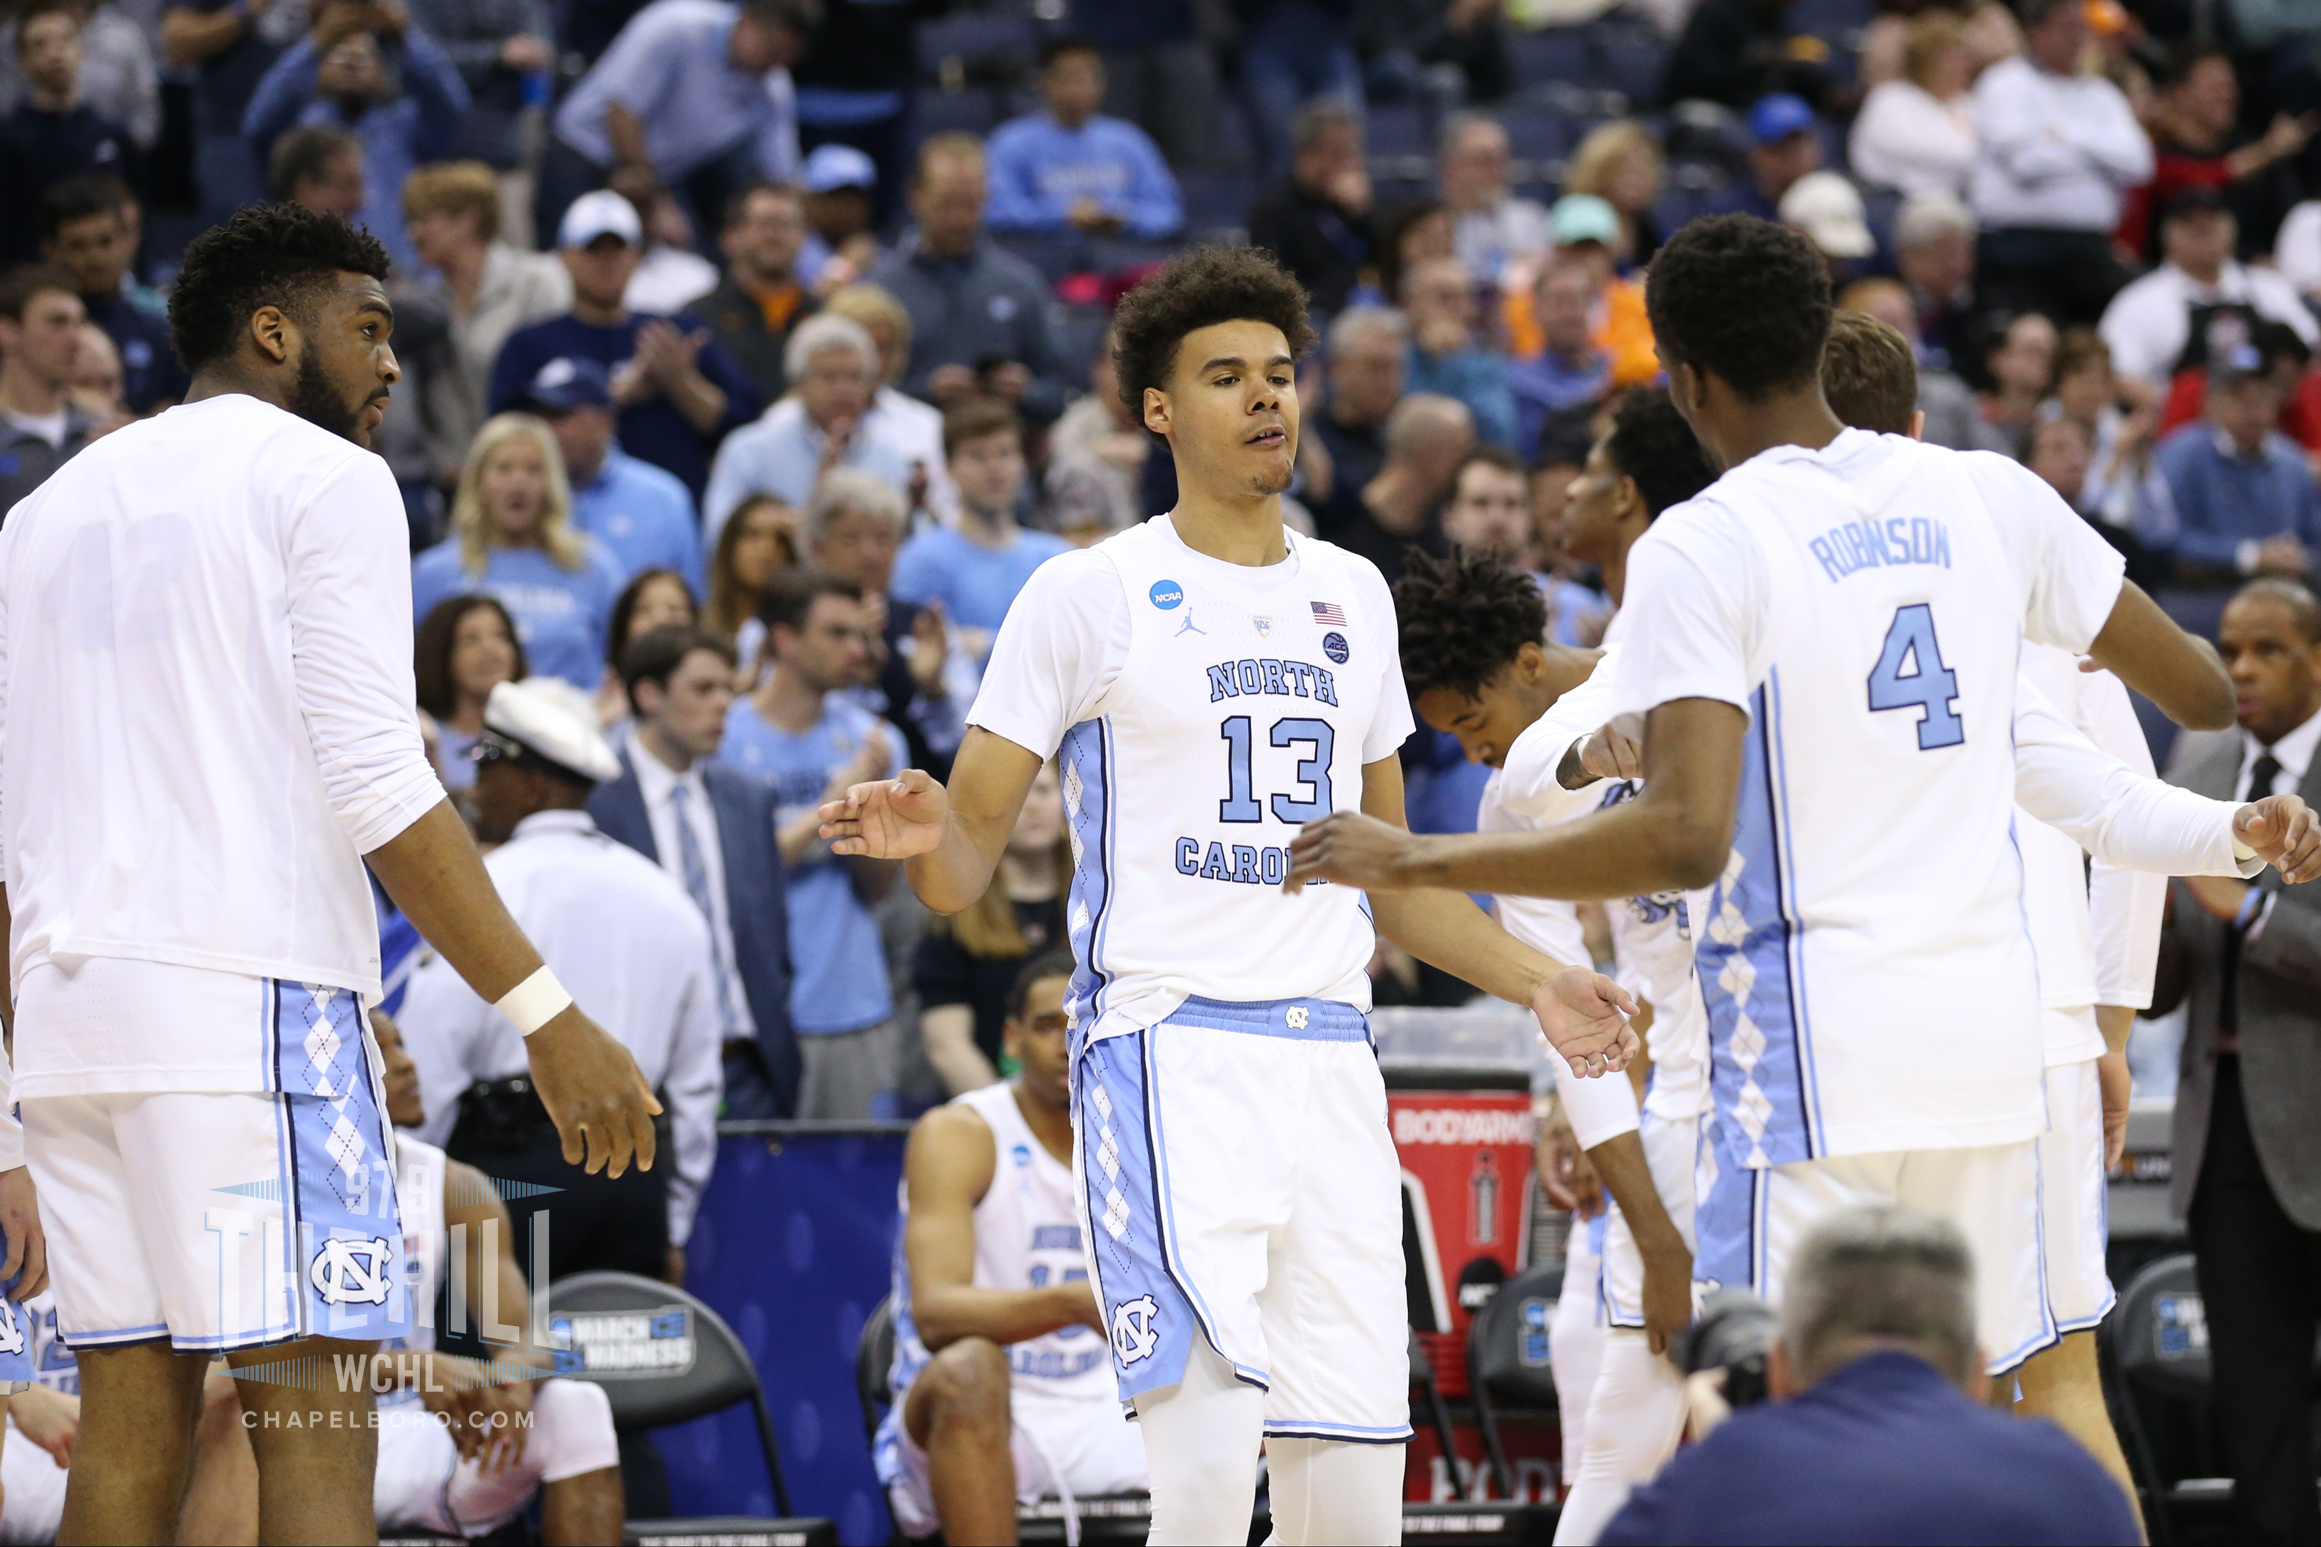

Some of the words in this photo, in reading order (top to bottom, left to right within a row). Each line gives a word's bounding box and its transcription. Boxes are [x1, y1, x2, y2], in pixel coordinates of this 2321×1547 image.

[1808, 516, 1952, 584] ROBNSON
[1155, 591, 1182, 602] NCAA
[1328, 642, 1347, 651] ACC
[1206, 658, 1339, 708] NORTH
[1867, 602, 1965, 751] 4
[1219, 715, 1336, 825] 13
[1175, 836, 1333, 885] CARO
